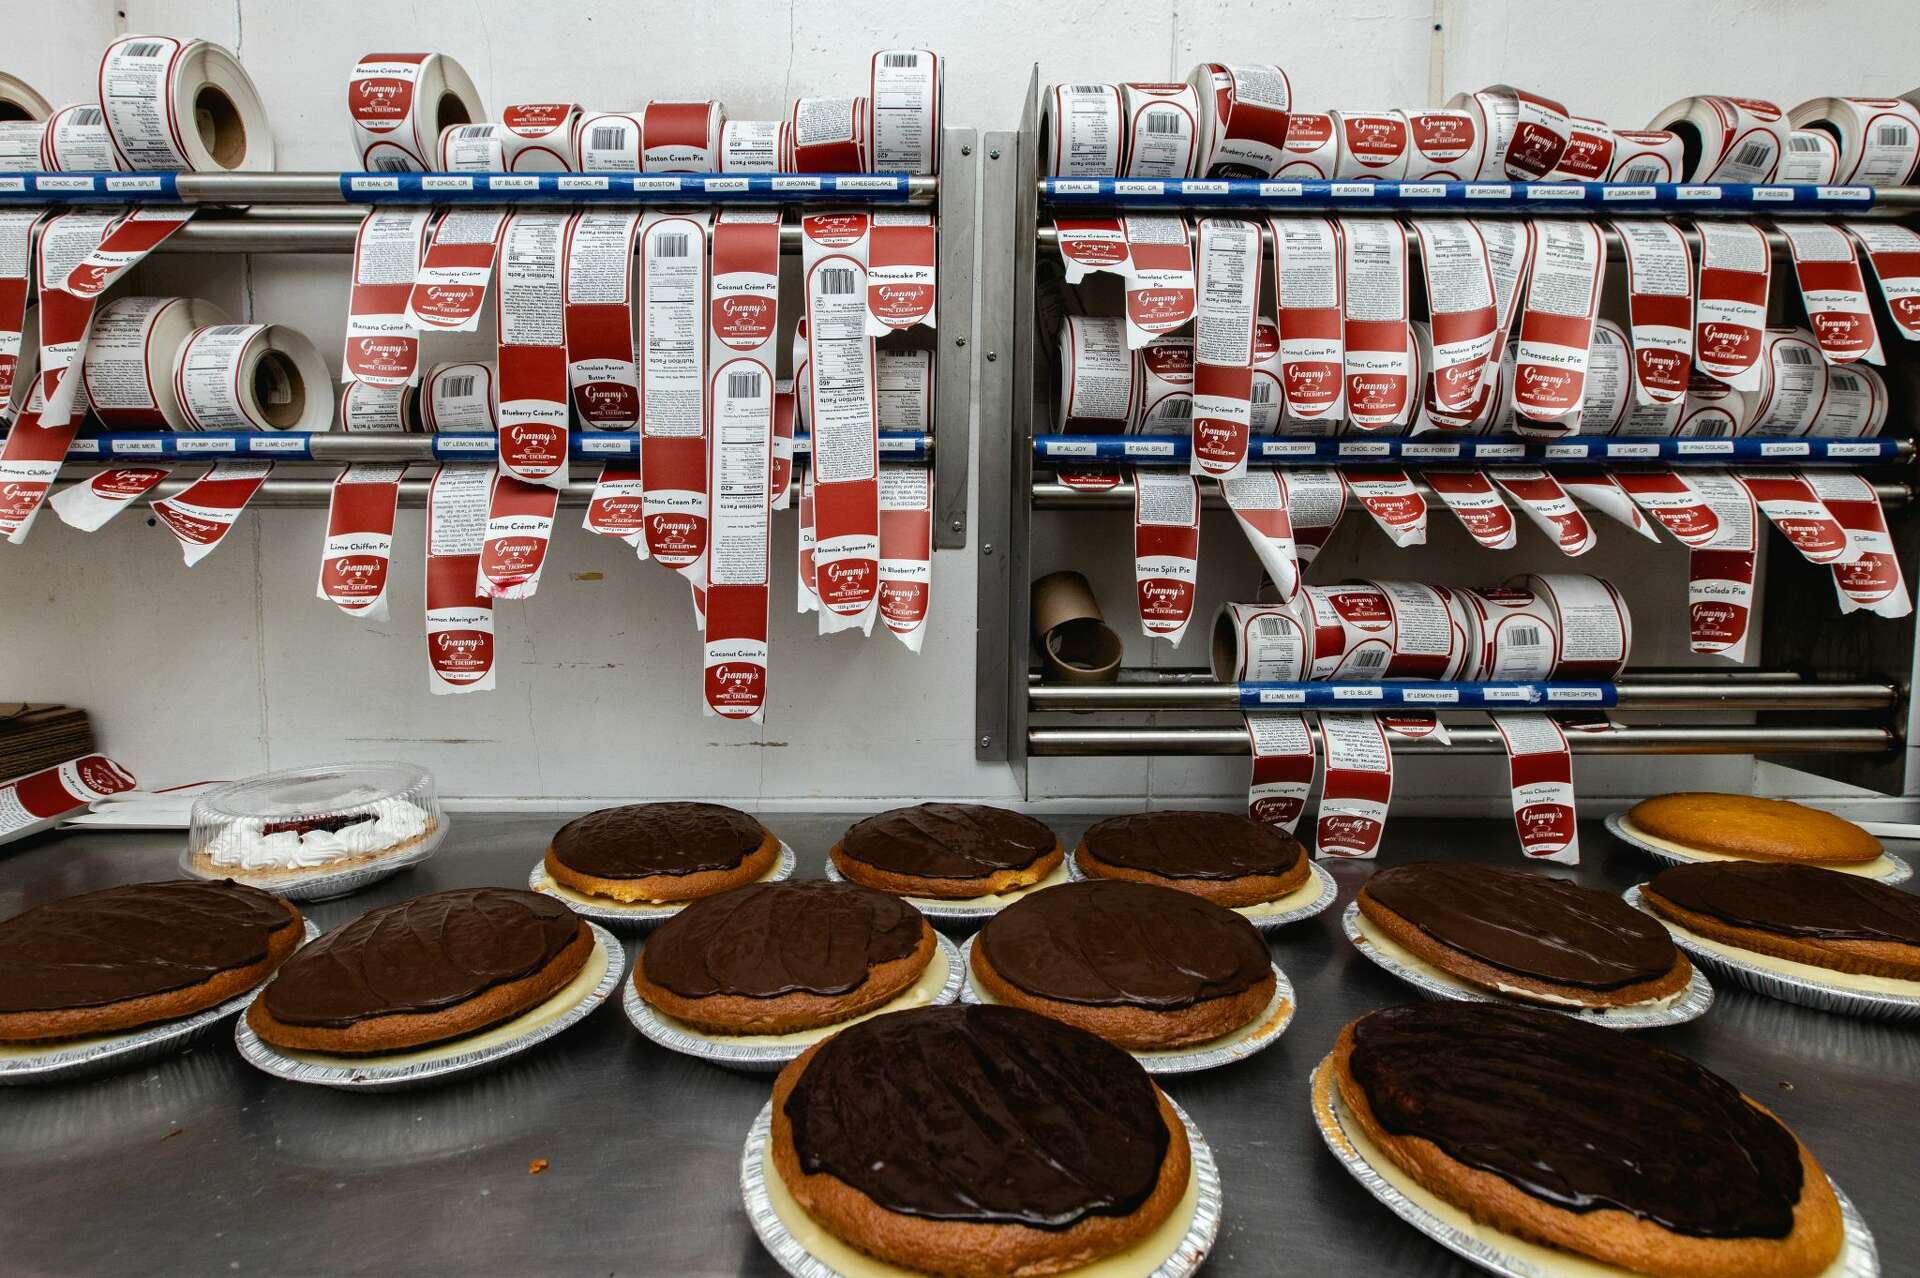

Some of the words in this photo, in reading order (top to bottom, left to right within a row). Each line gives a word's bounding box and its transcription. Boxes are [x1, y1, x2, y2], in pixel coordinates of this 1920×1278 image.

[360, 80, 403, 98] Granny's
[1354, 119, 1396, 134] Granny's
[1419, 116, 1464, 130] Granny's
[1523, 124, 1557, 150] Granny's
[1220, 146, 1245, 160] Blueberry
[1265, 154, 1273, 162] Pie
[868, 271, 916, 280] Cheesecake
[918, 271, 928, 280] Pie
[428, 286, 474, 300] Granny's
[716, 283, 744, 291] Coconut
[766, 283, 776, 291] Pie
[878, 286, 924, 300] Granny's
[1137, 290, 1184, 306] Granny's
[723, 298, 767, 316] Granny's
[353, 322, 380, 331] Banana
[1816, 315, 1859, 333] Granny's
[1704, 324, 1750, 342] Granny's
[360, 338, 408, 355] Granny's
[1366, 359, 1389, 368] Cream
[1391, 359, 1402, 368] Pie
[1520, 348, 1565, 363] Cheesecake
[1567, 355, 1582, 364] Pie
[1642, 350, 1680, 367] Granny's
[1289, 364, 1331, 382] Granny's
[1524, 366, 1571, 388] Granny's
[1352, 376, 1396, 395] Granny's
[584, 386, 628, 402] Granny's
[838, 395, 865, 403] Nutrition
[502, 410, 531, 418] Blueberry
[554, 410, 564, 418] Pie
[512, 426, 558, 445] Granny's
[1199, 420, 1237, 437] Granny's
[643, 496, 666, 506] Boston
[667, 496, 690, 506] Cream
[691, 496, 702, 506] Pie
[1366, 498, 1410, 509] Granny's
[1652, 508, 1698, 522] Granny's
[489, 522, 509, 530] Lime
[538, 522, 550, 530] Pie
[653, 515, 697, 534] Granny's
[1778, 520, 1825, 535] Granny's
[330, 543, 348, 551] Lime
[350, 543, 378, 551] Chiffon
[379, 543, 389, 551] Pie
[494, 540, 538, 556] Granny's
[817, 546, 840, 554] Brownie
[841, 545, 866, 554] Supreme
[335, 559, 380, 577] Granny's
[828, 561, 870, 581] Granny's
[887, 566, 916, 575] Blueberry
[917, 566, 926, 575] Pie
[1160, 564, 1179, 575] Split
[1180, 566, 1190, 574] Pie
[879, 582, 920, 600] Granny's
[1143, 580, 1184, 600] Granny's
[1704, 586, 1730, 595] Colada
[1732, 588, 1746, 596] Pie
[1338, 592, 1378, 605] Granny's
[426, 615, 448, 623] Lemon
[449, 615, 478, 623] Meringue
[480, 615, 488, 623] Pie
[1692, 604, 1735, 620] Granny's
[437, 633, 484, 651] Granny's
[710, 650, 736, 658] Coconut
[758, 650, 766, 658] Pie
[716, 665, 759, 684] Granny's
[1255, 799, 1292, 813] Granny's
[1522, 807, 1562, 825] Granny's
